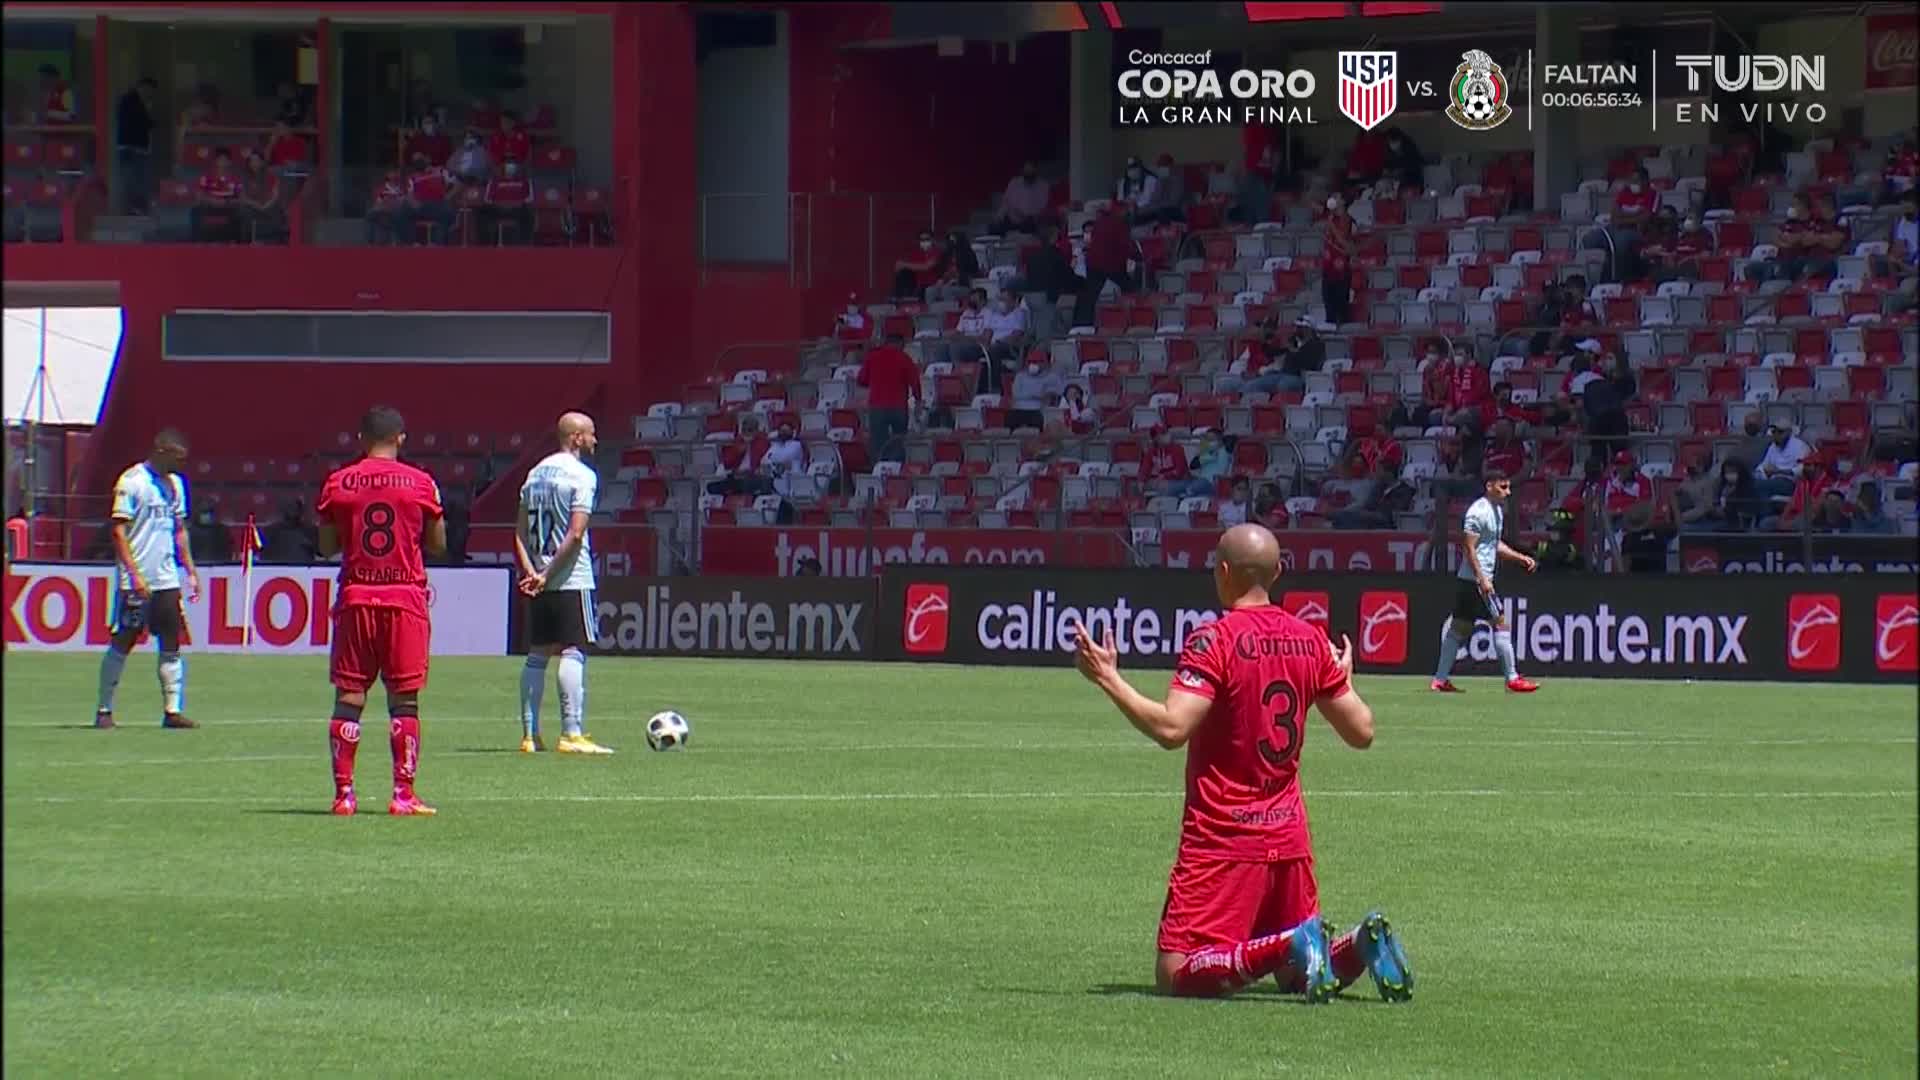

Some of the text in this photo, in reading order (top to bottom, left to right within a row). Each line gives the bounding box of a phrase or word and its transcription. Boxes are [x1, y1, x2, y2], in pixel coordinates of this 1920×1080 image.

[361, 501, 396, 558] 8
[207, 576, 332, 647] LO
[595, 585, 863, 653] caliente.mx
[977, 589, 1226, 655] caliente.m
[1236, 631, 1317, 664] Corona
[1258, 680, 1299, 764] 3
